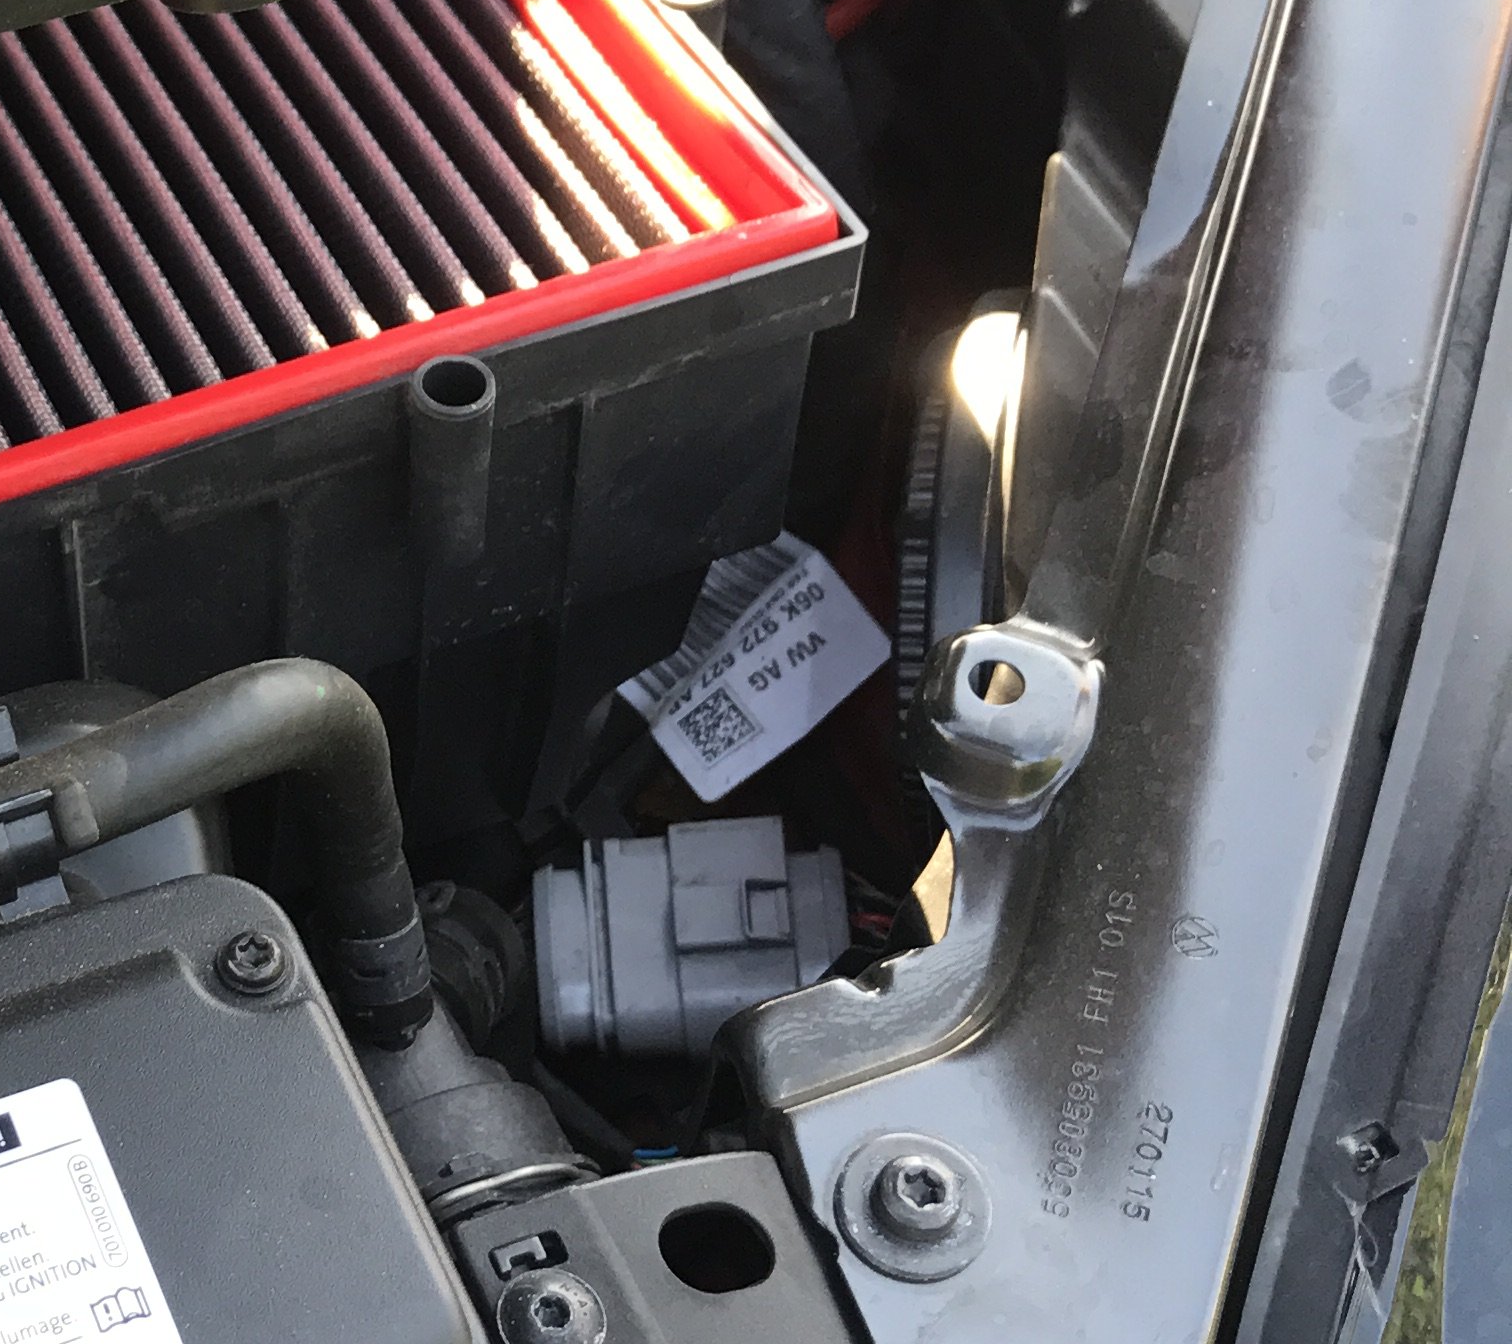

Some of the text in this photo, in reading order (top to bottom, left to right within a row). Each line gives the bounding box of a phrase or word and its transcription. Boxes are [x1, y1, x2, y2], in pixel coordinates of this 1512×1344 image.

[779, 581, 822, 621] 06K
[747, 628, 826, 694] VW AG
[72, 1158, 122, 1261] 701 010 690 B
[8, 1253, 96, 1296] IGNITION
